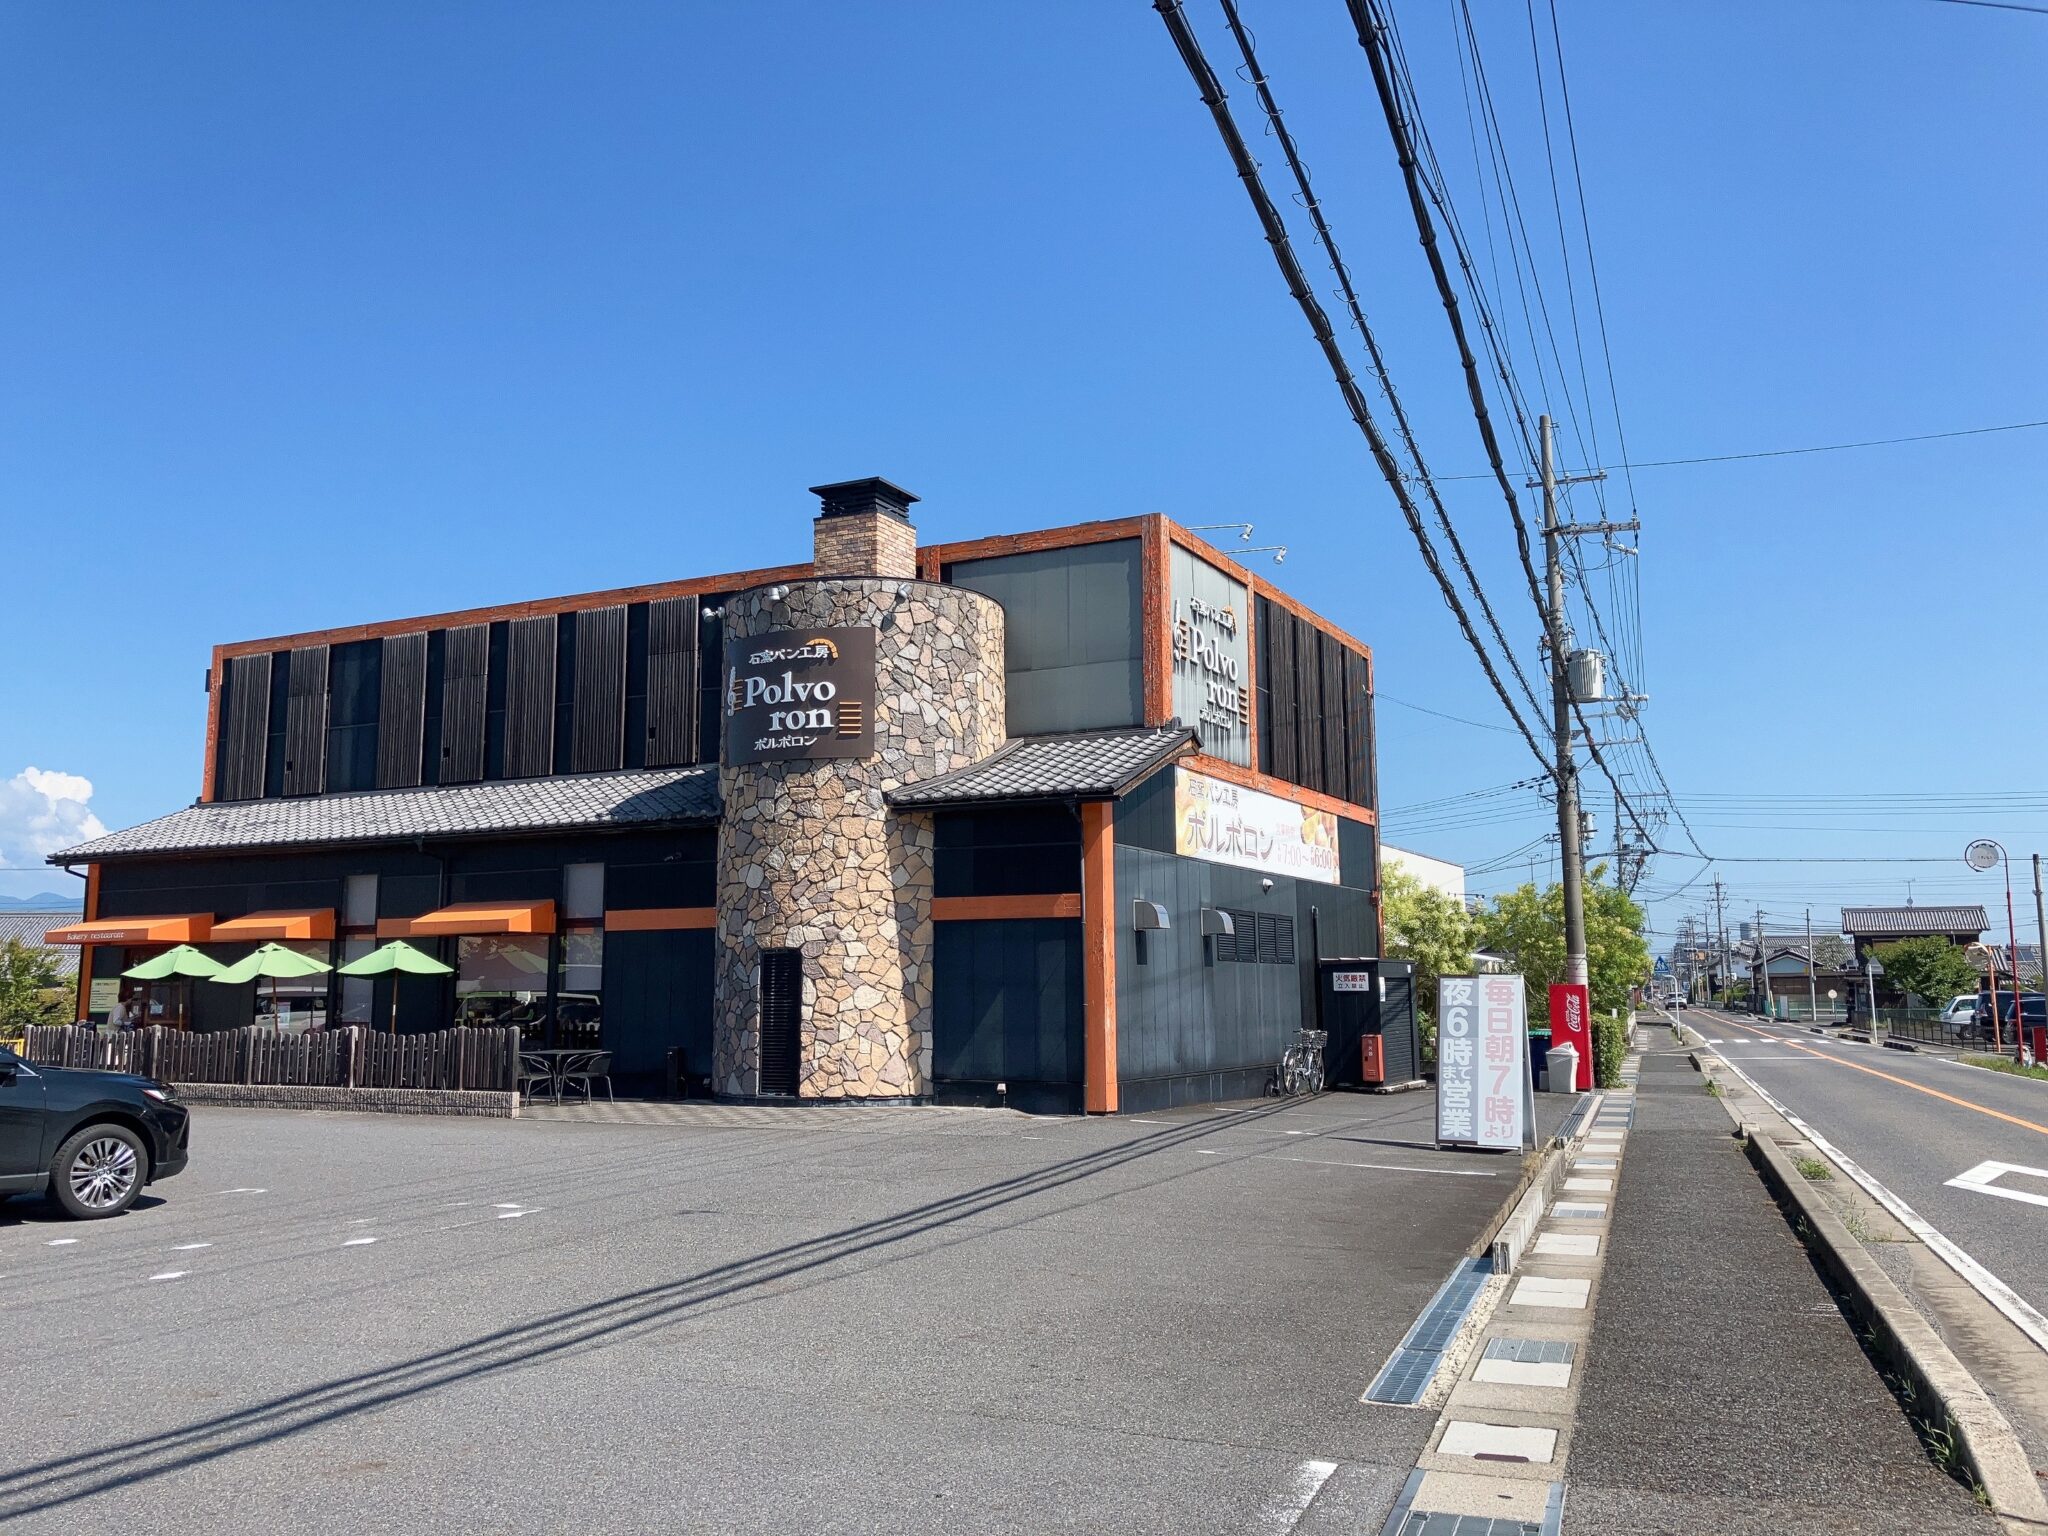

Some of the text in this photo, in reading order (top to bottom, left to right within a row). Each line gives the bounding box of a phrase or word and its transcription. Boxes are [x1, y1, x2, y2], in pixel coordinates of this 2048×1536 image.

[1189, 626, 1239, 681] Polvo
[744, 671, 836, 707] Polvo
[1206, 680, 1239, 713] ron
[768, 708, 835, 731] ron
